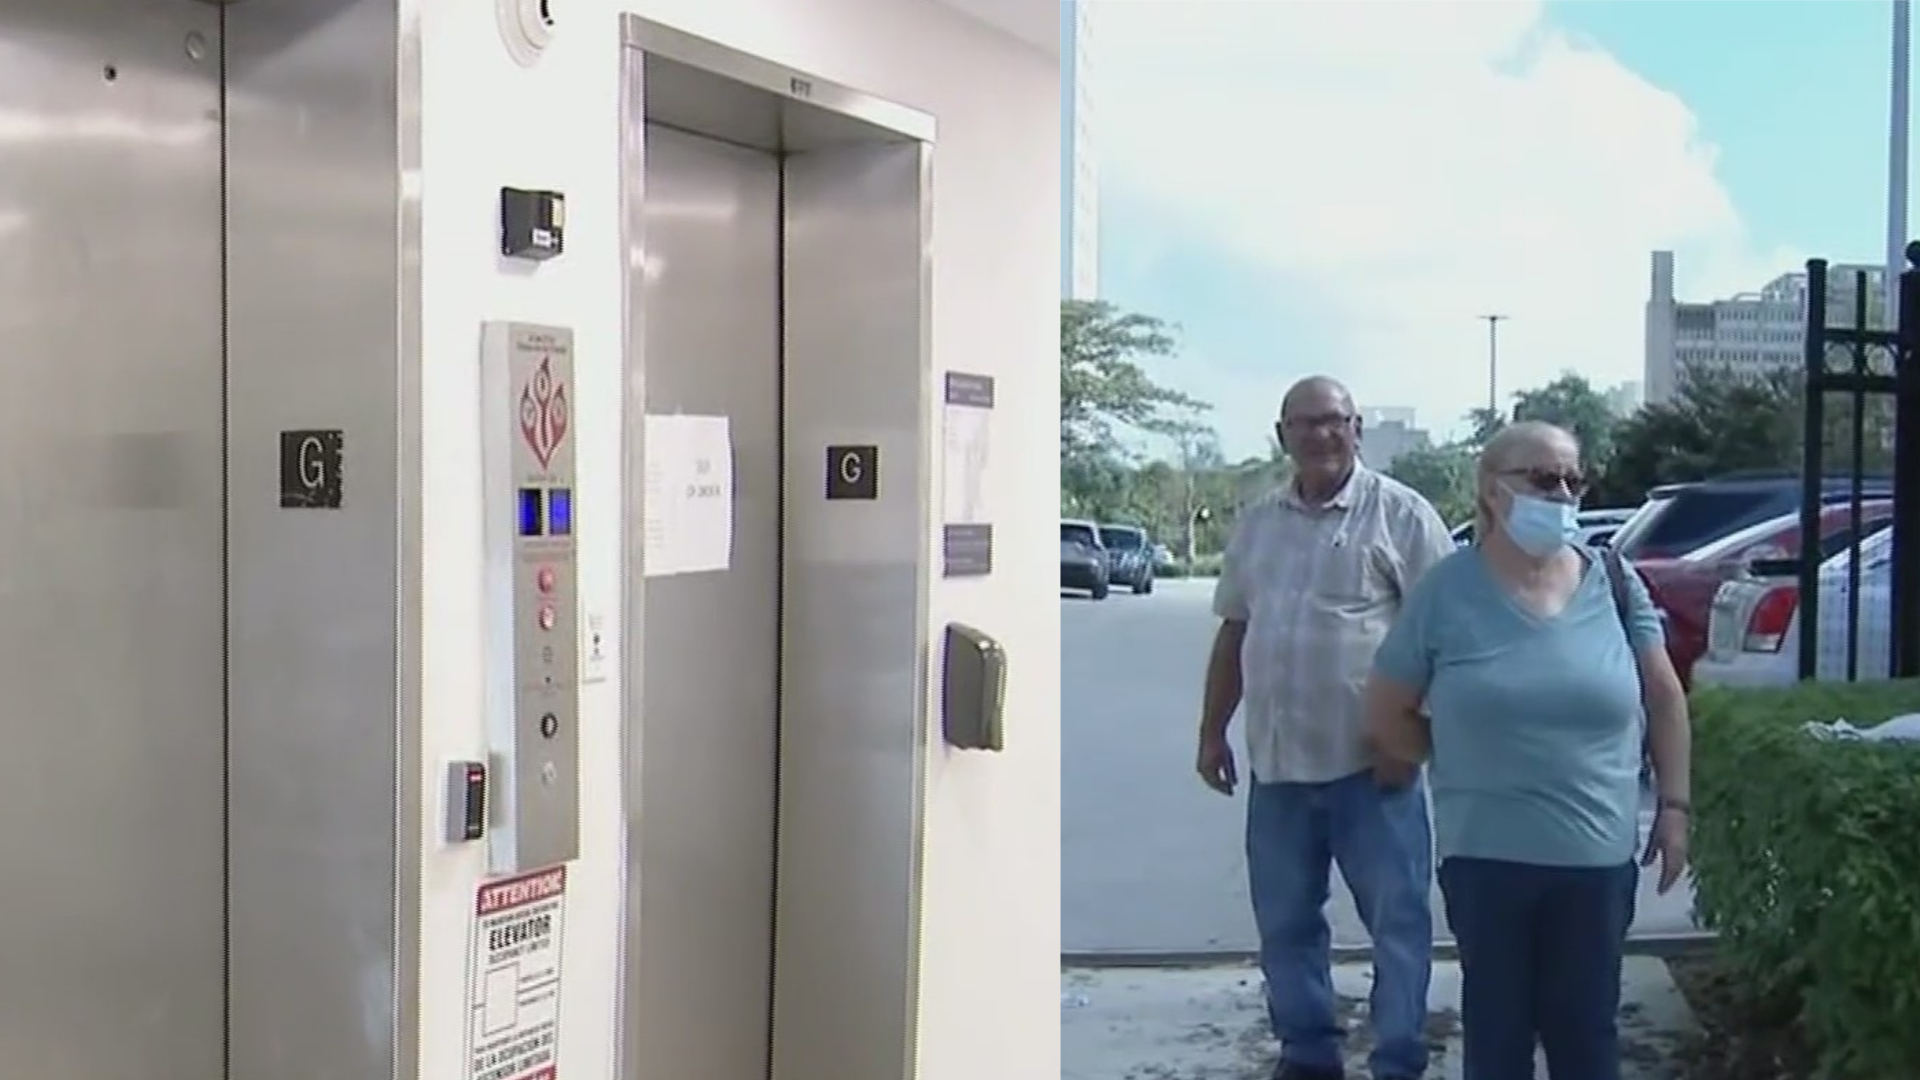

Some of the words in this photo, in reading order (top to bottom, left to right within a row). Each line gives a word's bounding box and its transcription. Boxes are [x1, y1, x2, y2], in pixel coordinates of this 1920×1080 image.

[301, 437, 324, 488] G
[841, 452, 861, 483] G
[481, 870, 560, 911] ATTENTION
[489, 914, 552, 951] ELEVATOR
